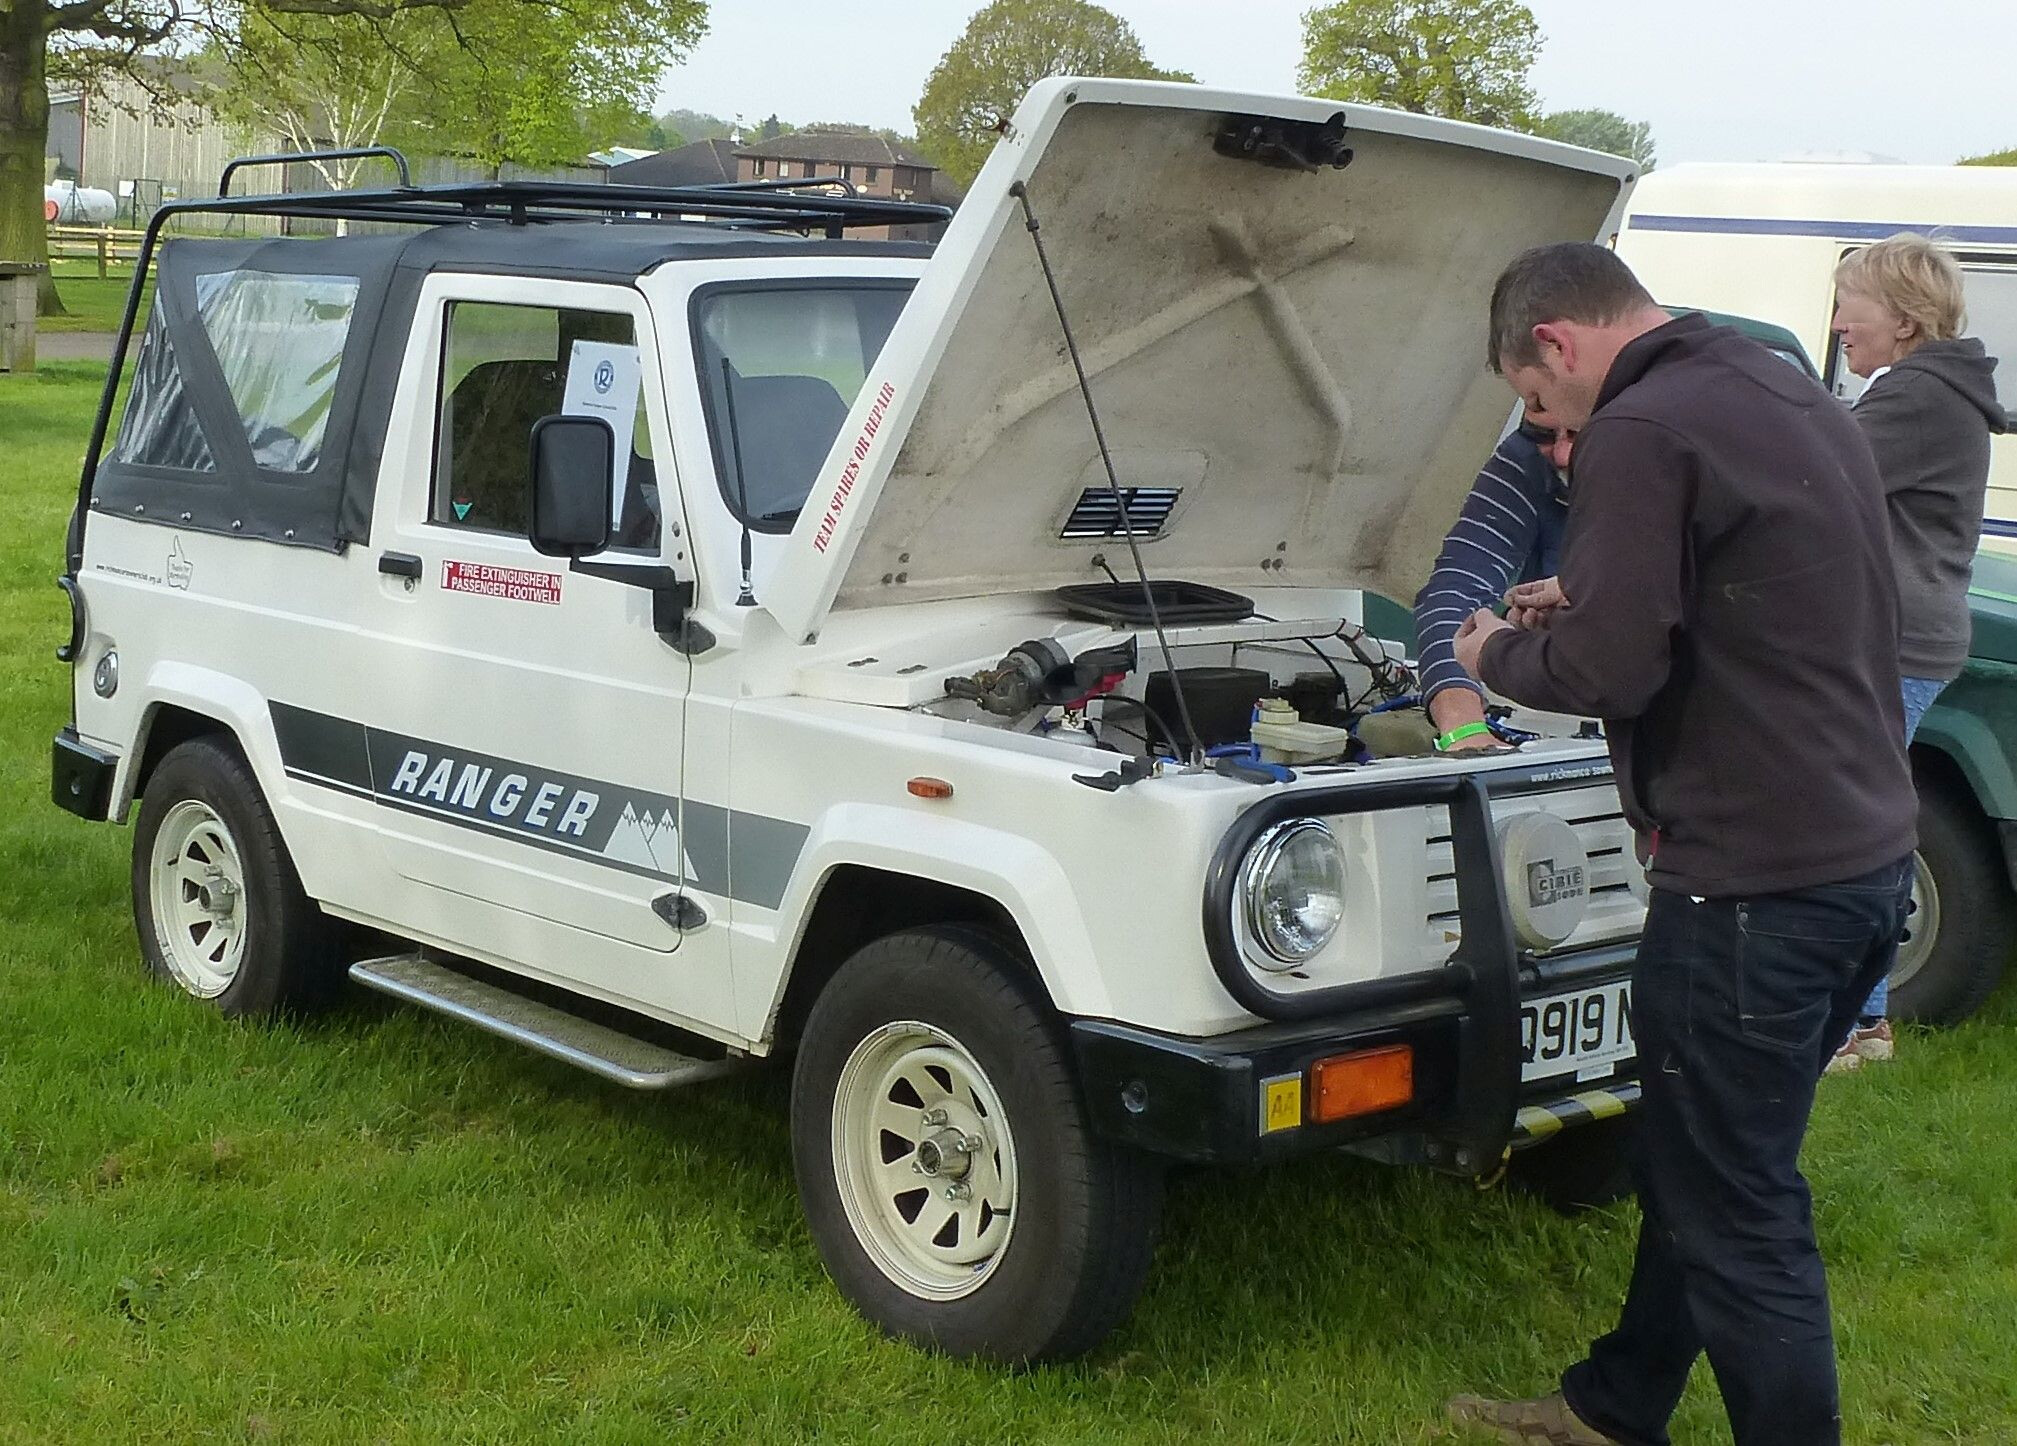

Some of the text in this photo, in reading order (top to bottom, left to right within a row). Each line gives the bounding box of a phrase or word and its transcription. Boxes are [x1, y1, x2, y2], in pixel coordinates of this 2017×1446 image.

[813, 381, 895, 555] TEAM SPARES OR REPAIR
[451, 577, 560, 604] PASSENGER FOOTWELL
[459, 563, 561, 590] FIRE EXTINGUISHER IN
[391, 750, 600, 837] RANGER
